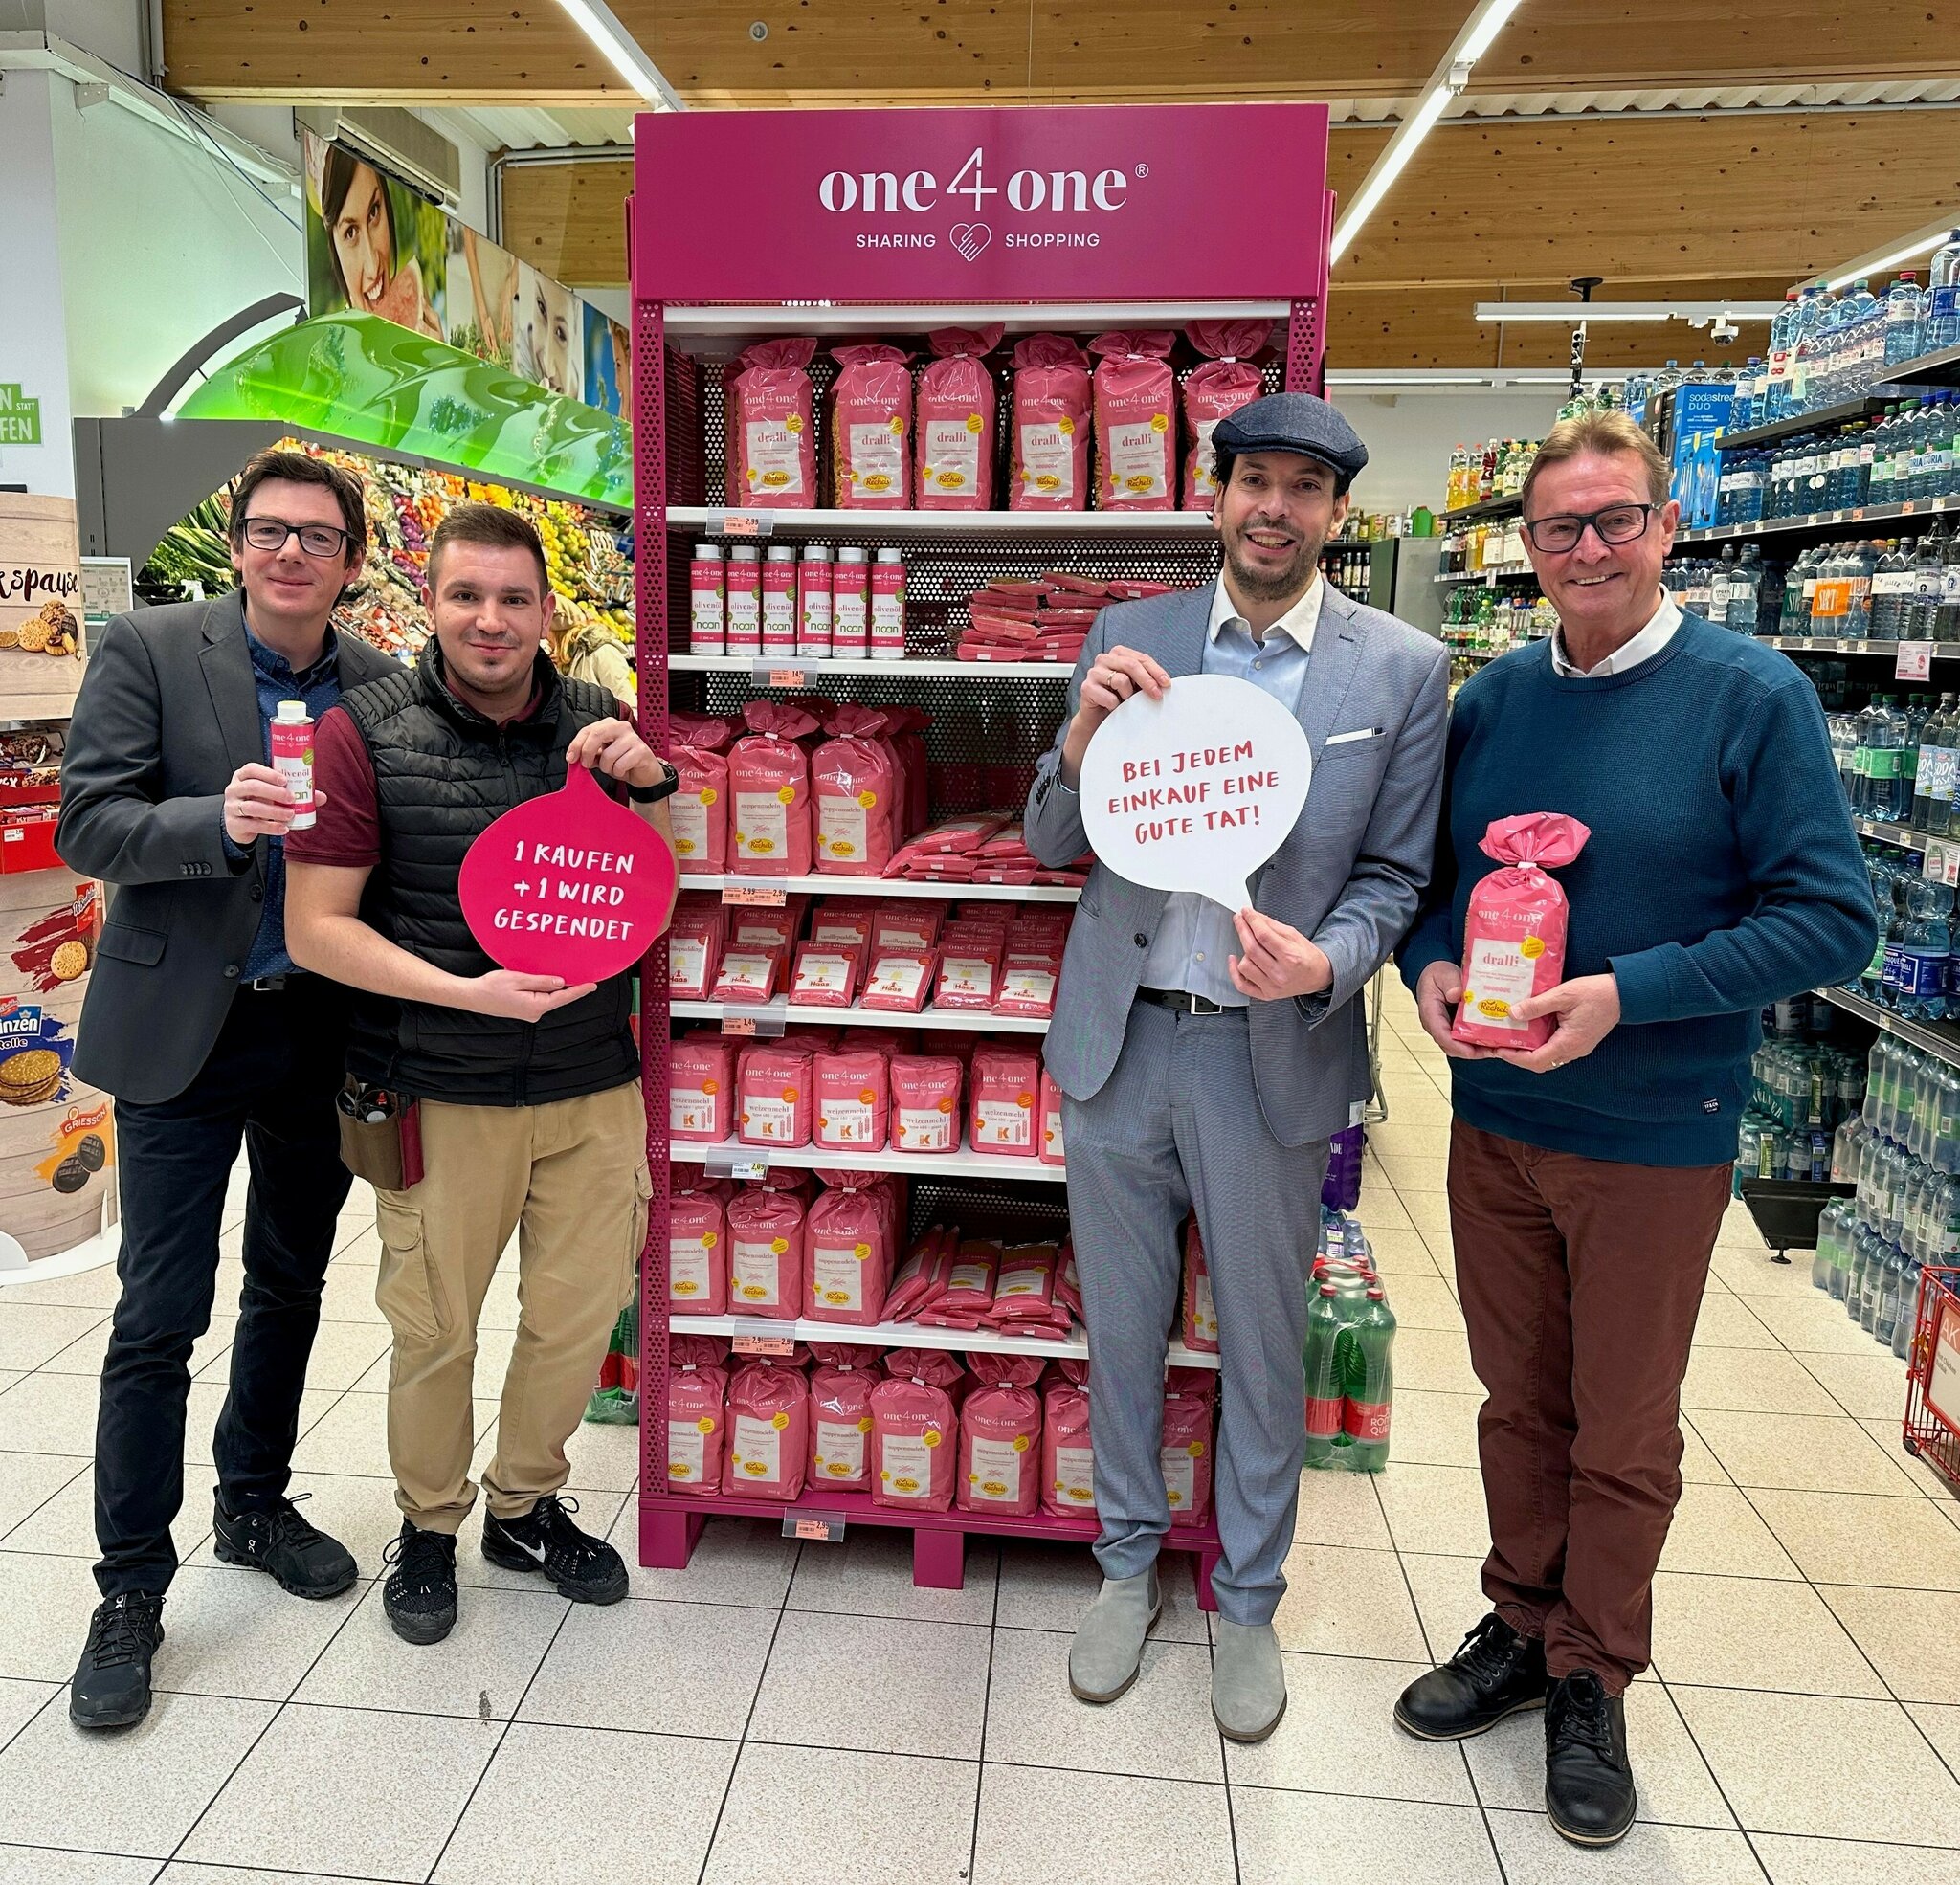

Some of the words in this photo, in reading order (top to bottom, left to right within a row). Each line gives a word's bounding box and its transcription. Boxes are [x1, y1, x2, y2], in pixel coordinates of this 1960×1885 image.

[856, 233, 936, 249] SHARING
[1004, 233, 1100, 249] SHOPPING
[1689, 392, 1735, 403] sodastrea
[16, 402, 35, 411] STATT
[1688, 402, 1711, 410] DUO
[861, 434, 891, 446] dralli
[937, 432, 967, 443] dralli
[1031, 435, 1060, 446] dralli
[1122, 433, 1152, 447] dralli
[696, 621, 720, 630] noan
[732, 622, 756, 631] noan
[875, 625, 899, 633] noan
[1122, 759, 1161, 783] BEI
[1171, 740, 1254, 774] JEDEM
[281, 768, 310, 778] livenöl
[1108, 782, 1211, 814] EINKAUF
[1223, 771, 1280, 795] EINE
[1135, 818, 1193, 845] GUTE
[1202, 805, 1260, 831] TAT!
[514, 840, 524, 861] 1
[533, 843, 635, 874] KAUFEN
[558, 880, 625, 906] WIRD
[494, 908, 635, 941] GESPENDET
[64, 1108, 106, 1134] GRIESSON
